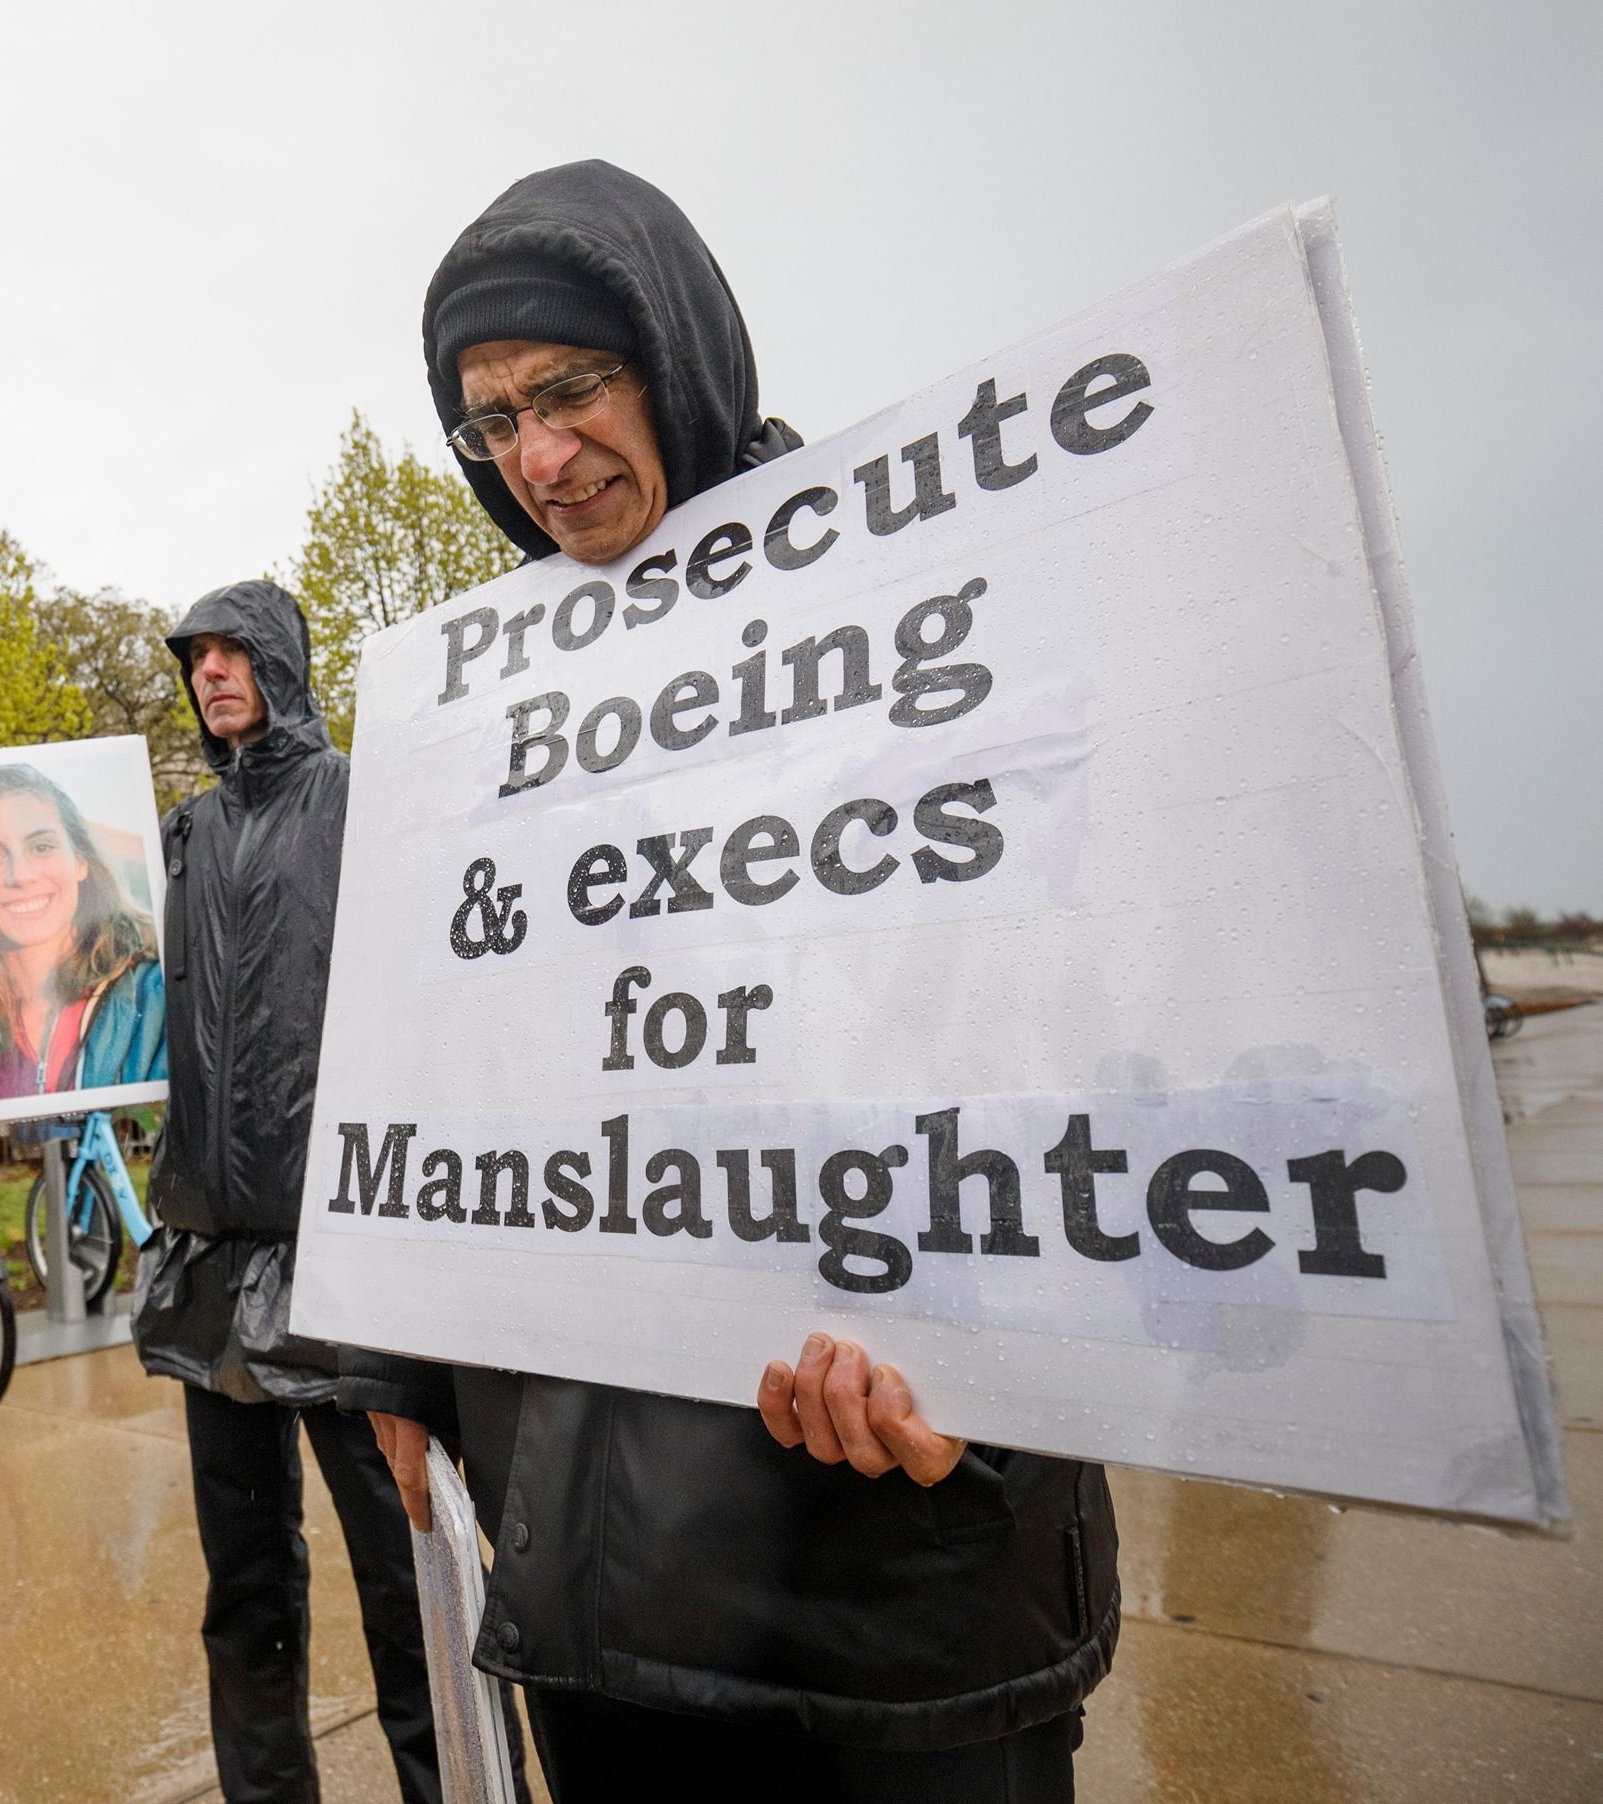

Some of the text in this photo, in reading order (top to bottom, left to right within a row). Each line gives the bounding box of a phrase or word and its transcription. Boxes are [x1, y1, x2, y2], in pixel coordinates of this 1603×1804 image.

[440, 353, 1154, 705] Prosecute
[498, 576, 994, 799] Boeing
[449, 778, 1005, 960] & execs
[601, 965, 773, 1072] for
[328, 1106, 1408, 1294] Manslaughter
